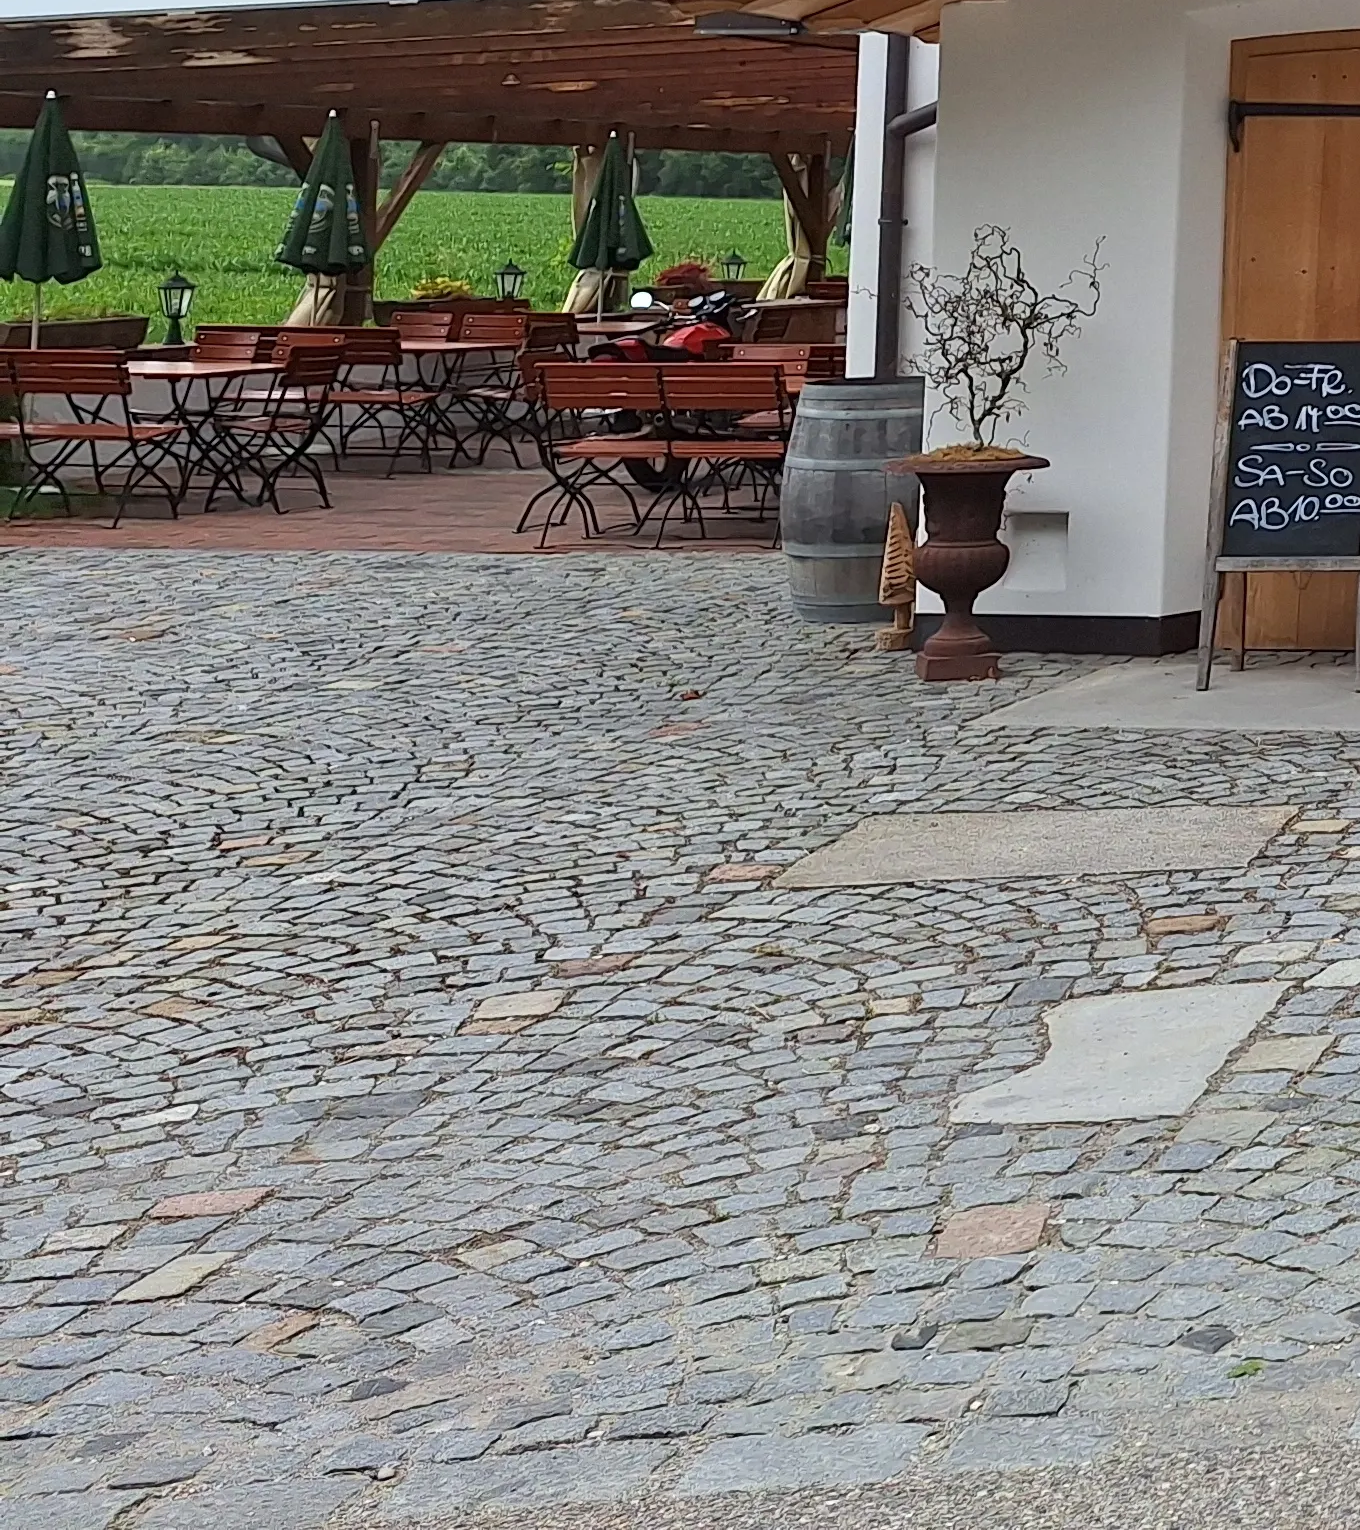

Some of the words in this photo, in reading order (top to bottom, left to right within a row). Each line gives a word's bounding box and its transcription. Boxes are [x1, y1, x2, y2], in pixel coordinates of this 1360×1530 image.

[1237, 404, 1289, 431] AB
[1234, 454, 1354, 488] SA-SO
[1229, 496, 1289, 531] AB
